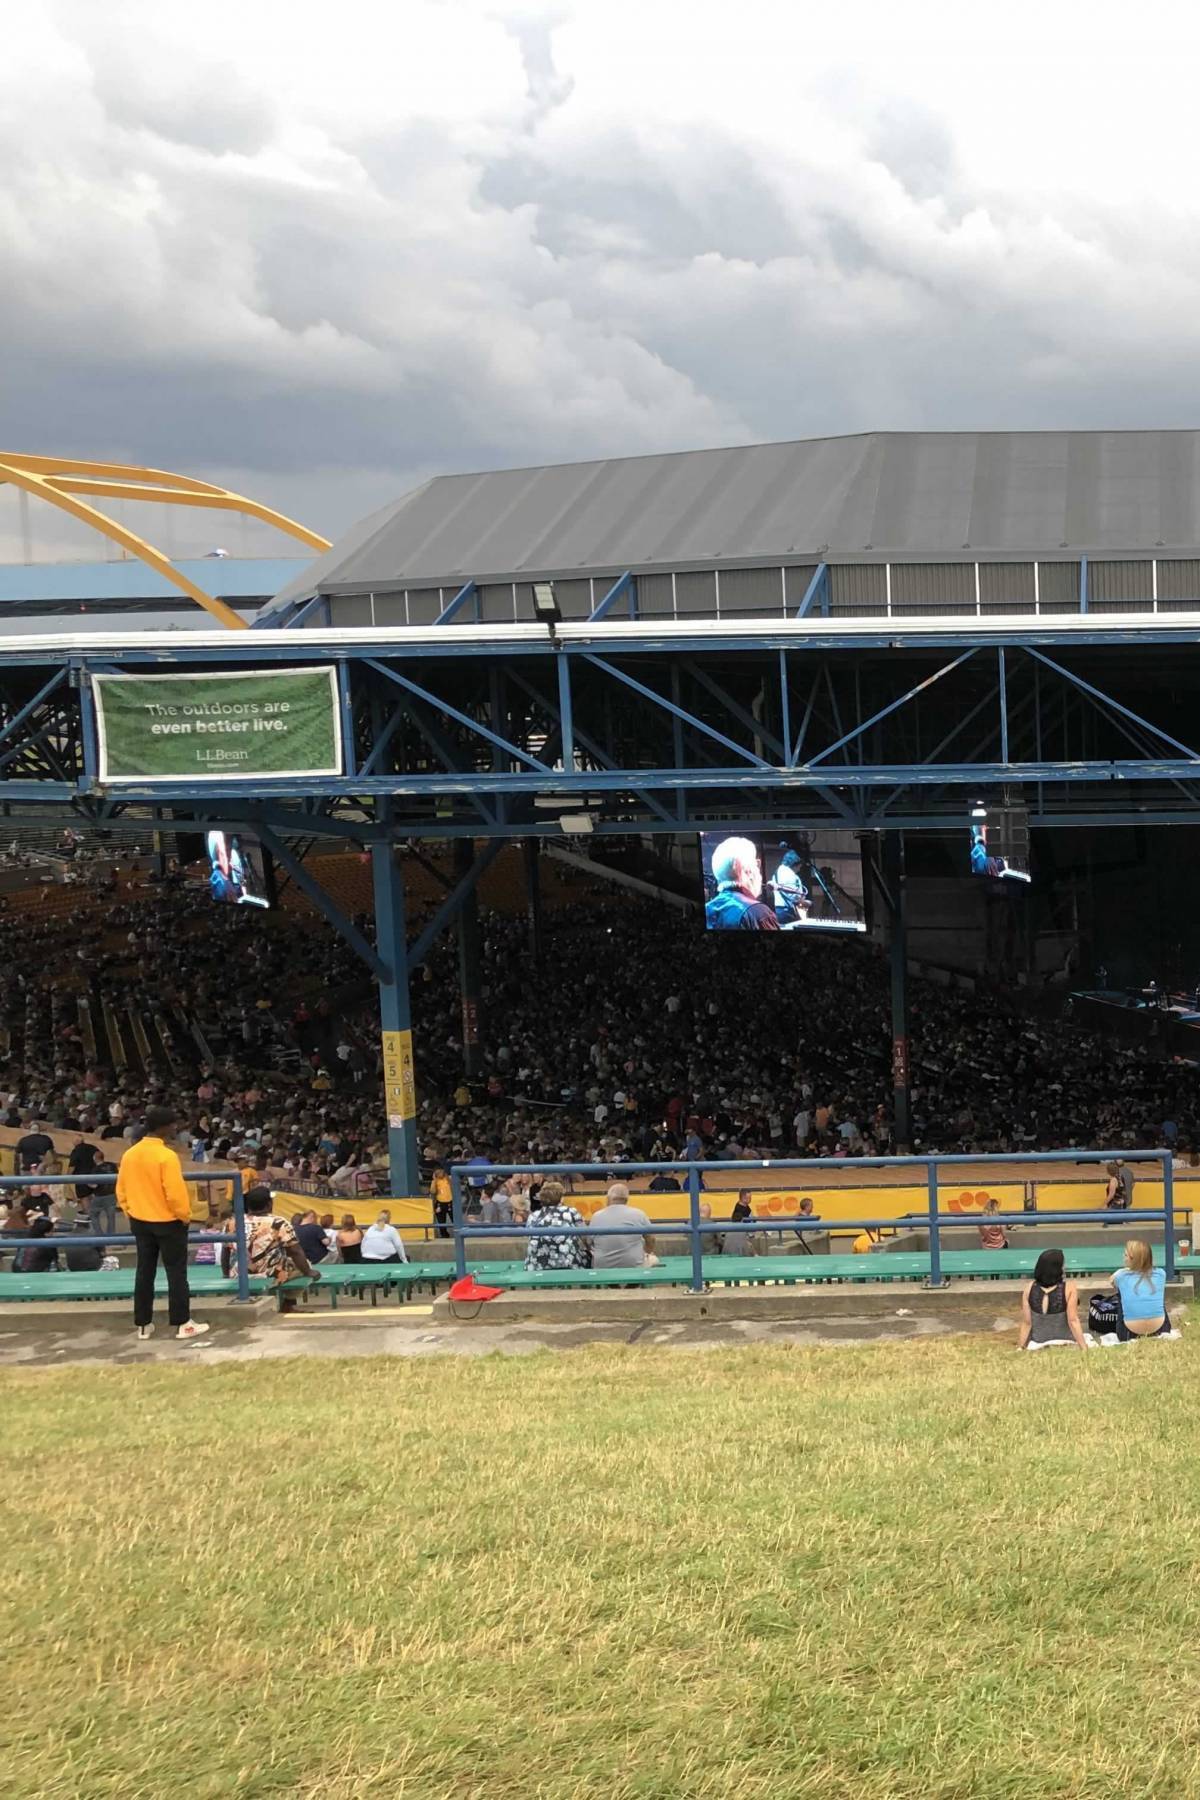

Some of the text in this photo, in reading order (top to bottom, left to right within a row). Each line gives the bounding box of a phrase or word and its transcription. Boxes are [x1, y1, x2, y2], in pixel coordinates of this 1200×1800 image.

[144, 701, 290, 716] The outdoors are
[151, 718, 288, 735] even better live.
[387, 1042, 395, 1053] 4
[403, 1053, 410, 1067] 4
[389, 1065, 397, 1077] 5
